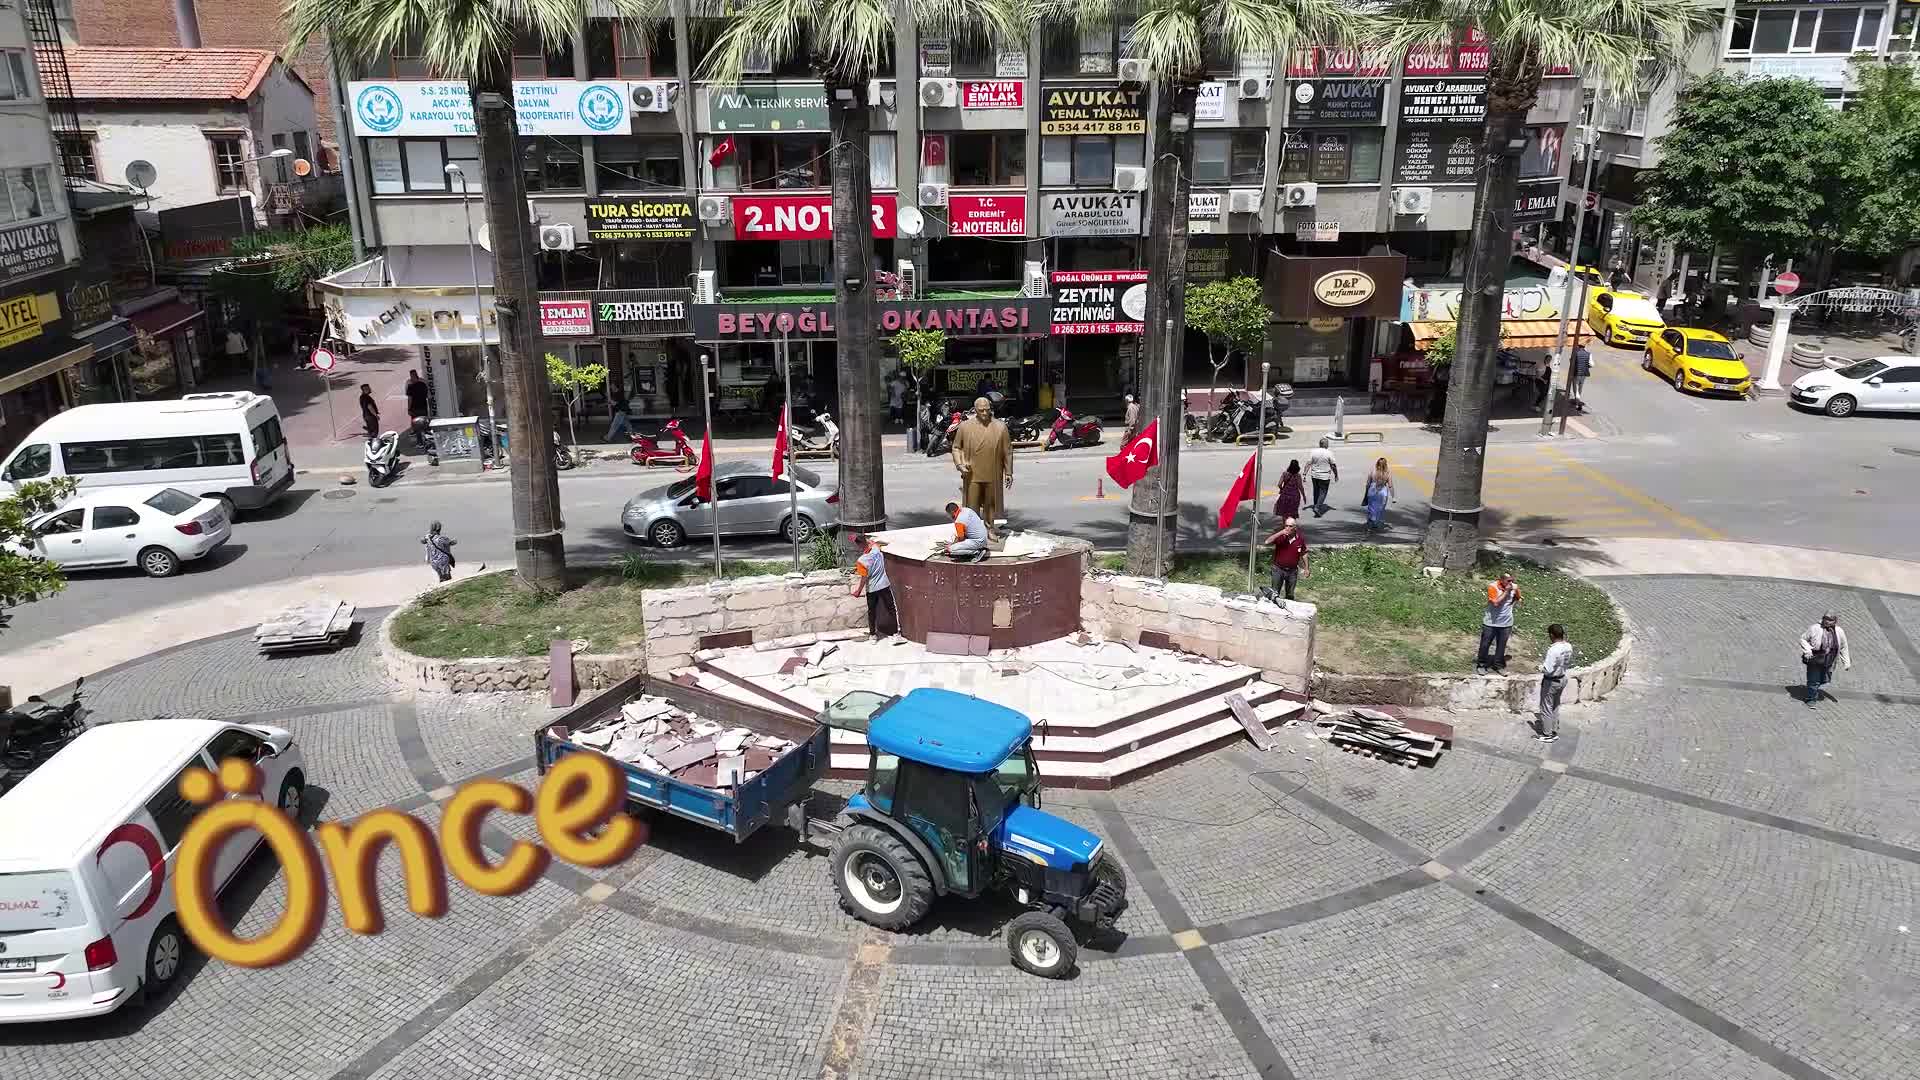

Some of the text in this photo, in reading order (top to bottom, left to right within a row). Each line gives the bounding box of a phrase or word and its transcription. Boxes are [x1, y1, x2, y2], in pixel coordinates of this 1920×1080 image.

[439, 86, 448, 95] 25
[451, 86, 473, 95] NOL
[970, 82, 1014, 92] SAYIM
[1322, 84, 1378, 98] AVUKAT
[1404, 85, 1434, 93] AVUKAT
[755, 96, 792, 109] TEKNİK
[968, 92, 1017, 102] EMLAK
[1048, 91, 1140, 106] AVUKAT
[518, 99, 549, 108] DALYAN
[410, 112, 454, 120] KARAYOLU
[1049, 108, 1139, 120] YENAL TAVŞAN
[1047, 122, 1140, 132] 0 534 417 88 16
[978, 198, 996, 207] T.C.
[1052, 196, 1135, 210] AVUKAT
[1189, 196, 1219, 207] VUKAT
[1528, 196, 1557, 209] EMLAK
[589, 200, 692, 217] TURA SİGORTA
[968, 210, 1006, 218] EDREMİT
[1064, 210, 1123, 218] ARABULUCU
[745, 204, 885, 232] 2.NOTR
[951, 218, 1023, 233] 2.NOTERLİĞİ
[0, 224, 49, 252] AVUKAT
[1056, 273, 1080, 282] DOĞAL
[1334, 278, 1358, 288] D&P
[1059, 284, 1114, 303] ZEYTİN
[1324, 288, 1366, 298] perfumum
[547, 307, 587, 319] EMLAK
[1054, 303, 1114, 321] ZEYTİNYAĞI
[718, 306, 1029, 334] BEYOĞL OKANTASI
